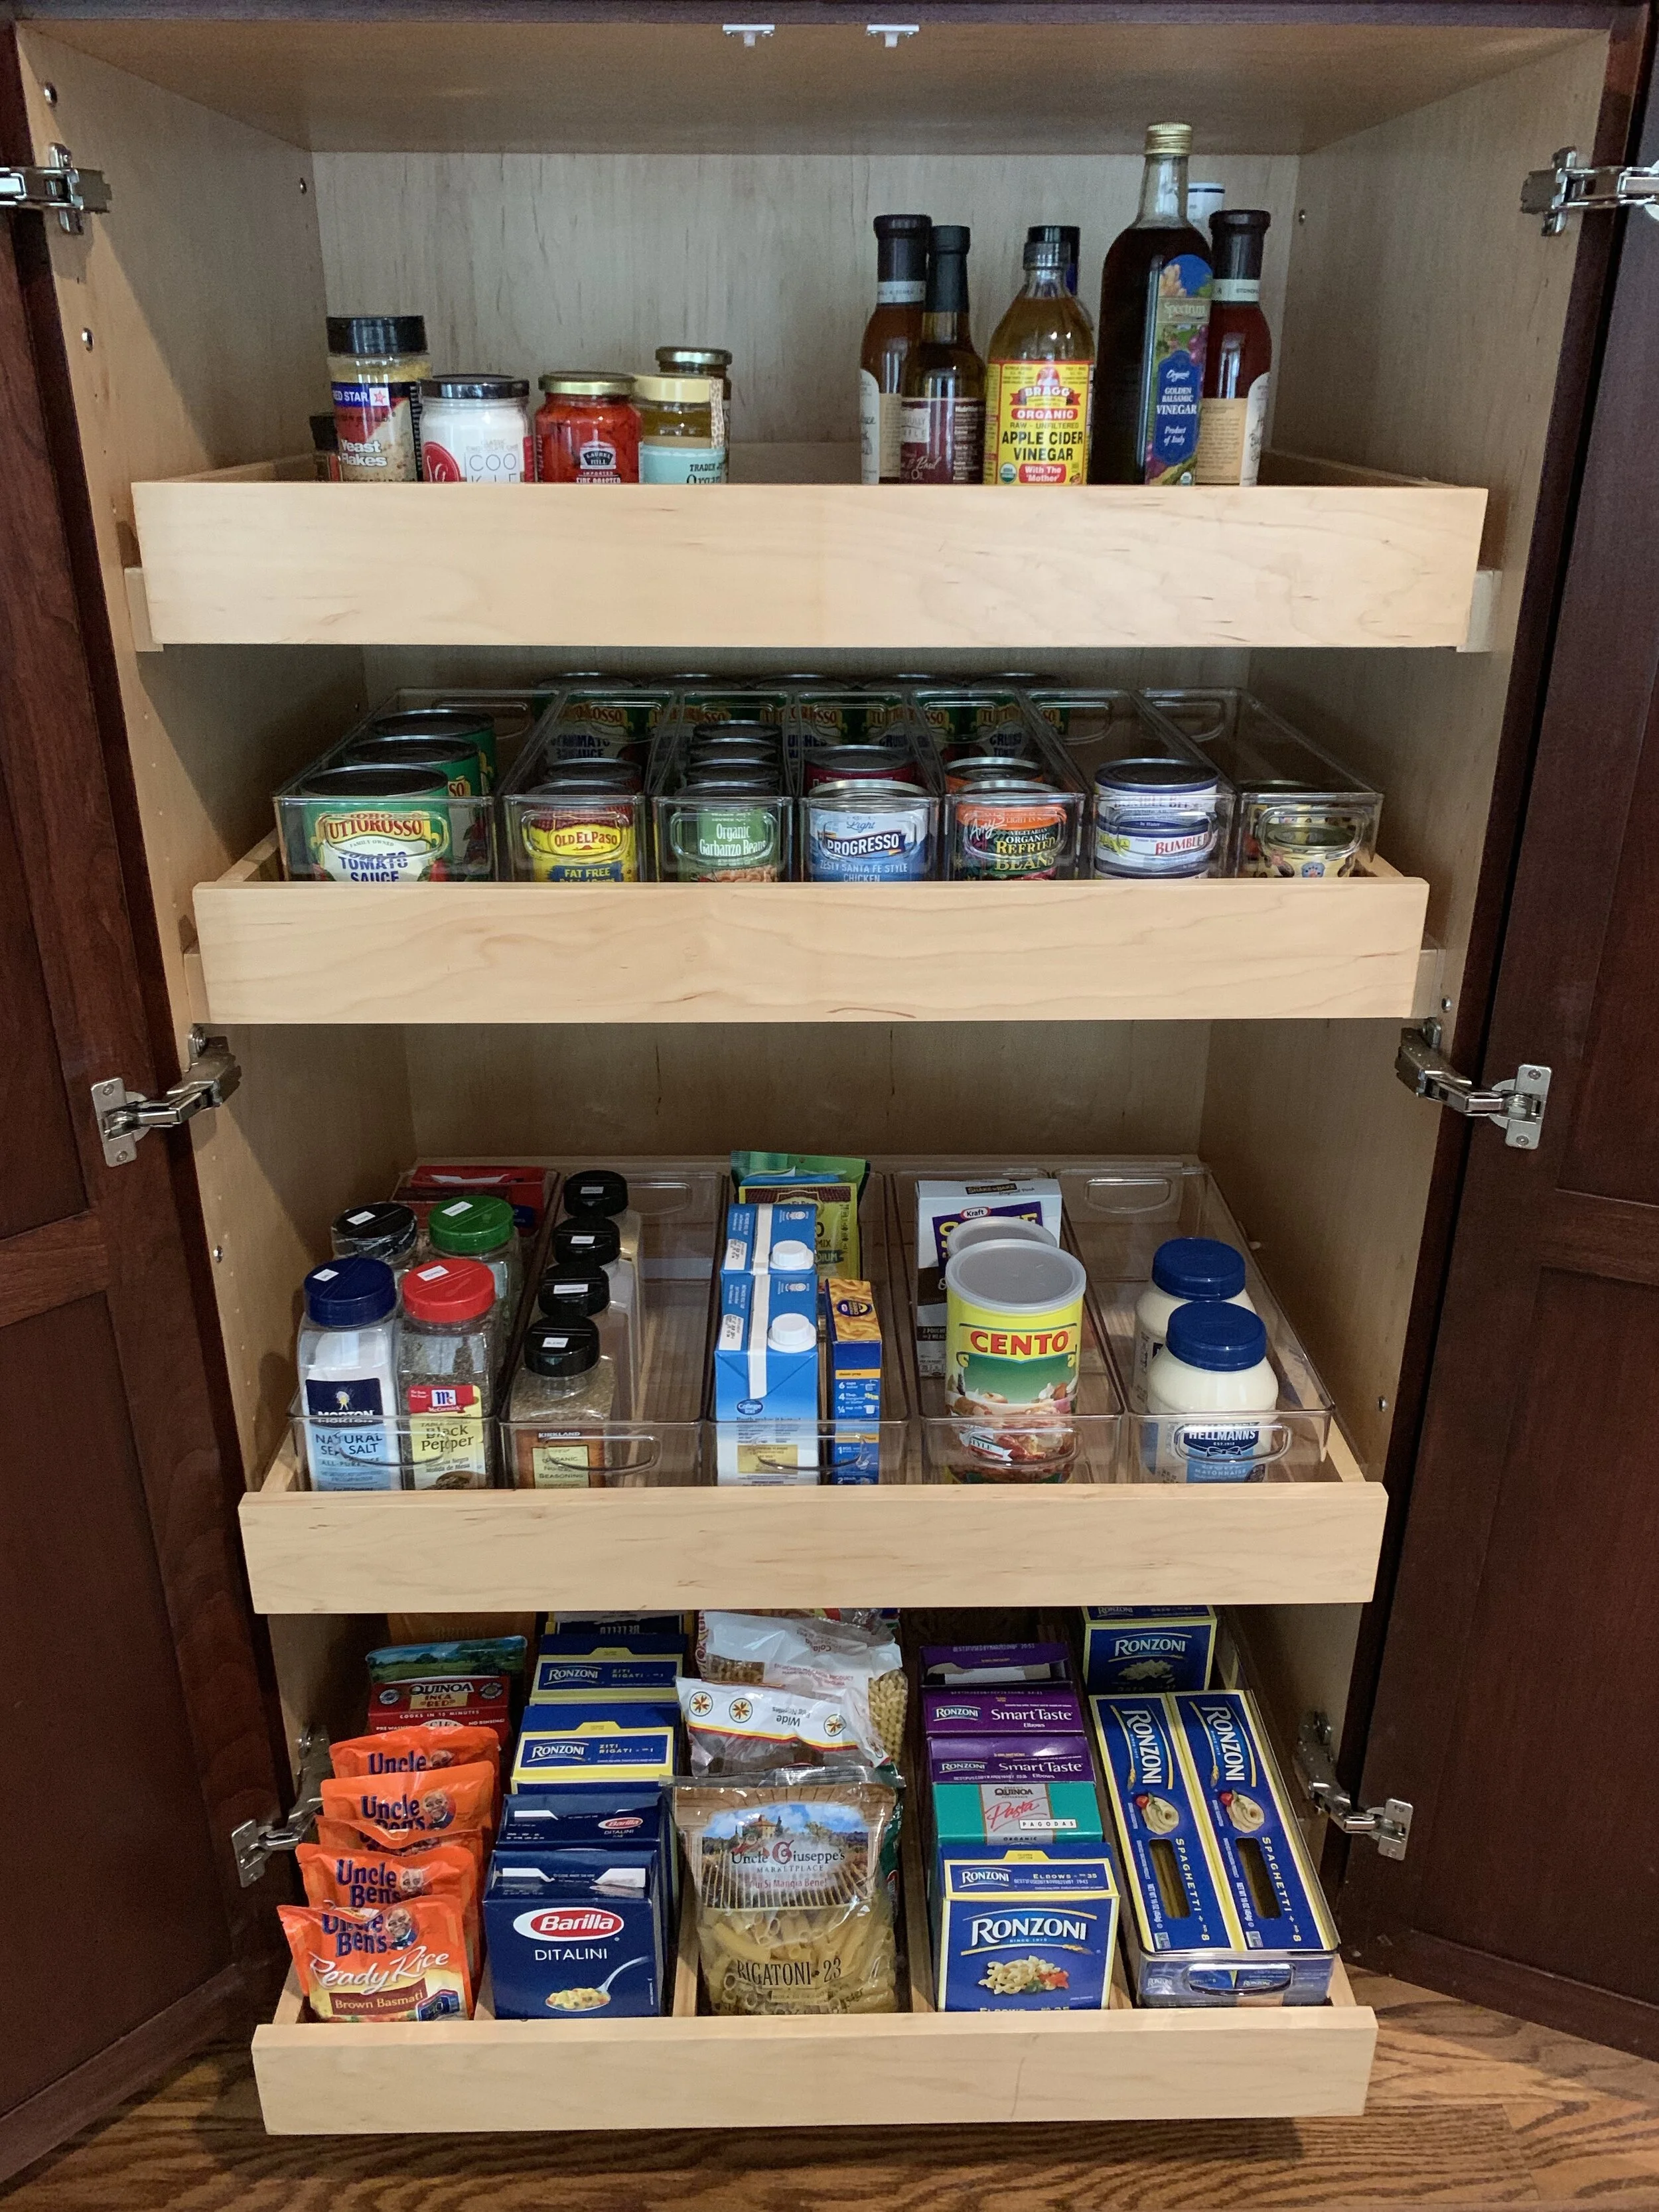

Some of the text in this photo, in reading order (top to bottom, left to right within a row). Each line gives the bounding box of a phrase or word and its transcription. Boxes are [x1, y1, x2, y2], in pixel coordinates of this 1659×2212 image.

[1164, 303, 1206, 318] Spectrum
[344, 391, 368, 402] STAR
[1025, 386, 1070, 396] BRAGG
[1017, 410, 1074, 419] ORGANIC
[1156, 405, 1197, 415] VINEGAR
[1002, 431, 1083, 445] APPLE CIDER
[341, 440, 382, 454] Yeast
[1014, 448, 1073, 461] VINEGAR
[328, 820, 423, 839] UTTOROSSO
[717, 823, 751, 842] Organic
[846, 821, 875, 834] Light
[555, 834, 575, 848] OLD
[576, 832, 591, 844] EL
[827, 833, 899, 856] PROGRESSO
[996, 836, 1055, 854] REFRIED
[1006, 833, 1050, 844] ORGANIC
[1155, 835, 1202, 855] BUMBLE
[699, 839, 766, 856] Garbanzo Beans
[338, 854, 409, 870] TOMATO
[820, 859, 908, 873] ZESTY SANTA FE STYLE
[350, 871, 399, 882] SAUCE
[565, 867, 611, 878] FAT FREE
[843, 873, 881, 882] CHICKEN
[966, 1209, 985, 1218] Kraft
[970, 1330, 1069, 1356] CENTO
[426, 1425, 469, 1439] Black
[349, 1443, 378, 1455] SALT
[421, 1436, 474, 1452] Pepper
[1115, 1639, 1186, 1657] RONZONI
[549, 1668, 599, 1682] RONZONI
[409, 1684, 472, 1695] QUINOA
[776, 1715, 800, 1727] Wide
[936, 1708, 978, 1718] RONZONI
[532, 1745, 585, 1759] RONZONI
[1121, 1710, 1162, 1784] RONZONI
[1201, 1707, 1245, 1781] RONZONI
[368, 1750, 427, 1775] Uncle
[361, 1794, 420, 1819] Uncle
[985, 1801, 1040, 1828] Pasta
[731, 1840, 845, 1865] Uncle Giuseppe's
[336, 1859, 397, 1886] Uncle
[962, 1870, 1009, 1883] RONZONI
[1175, 1838, 1202, 1911] SPAGHETTI
[1262, 1836, 1293, 1911] SPAGHETTI
[350, 1885, 401, 1908] Ben's
[540, 1914, 615, 1931] Barilla
[972, 1917, 1087, 1947] RONZONI
[336, 1932, 388, 1957] Ben's
[535, 1948, 608, 1961] DITALINI
[309, 1946, 450, 1996] Ready Rice
[737, 1958, 842, 1986] RIGATONI 23
[334, 1991, 423, 2010] Brown Basmati
